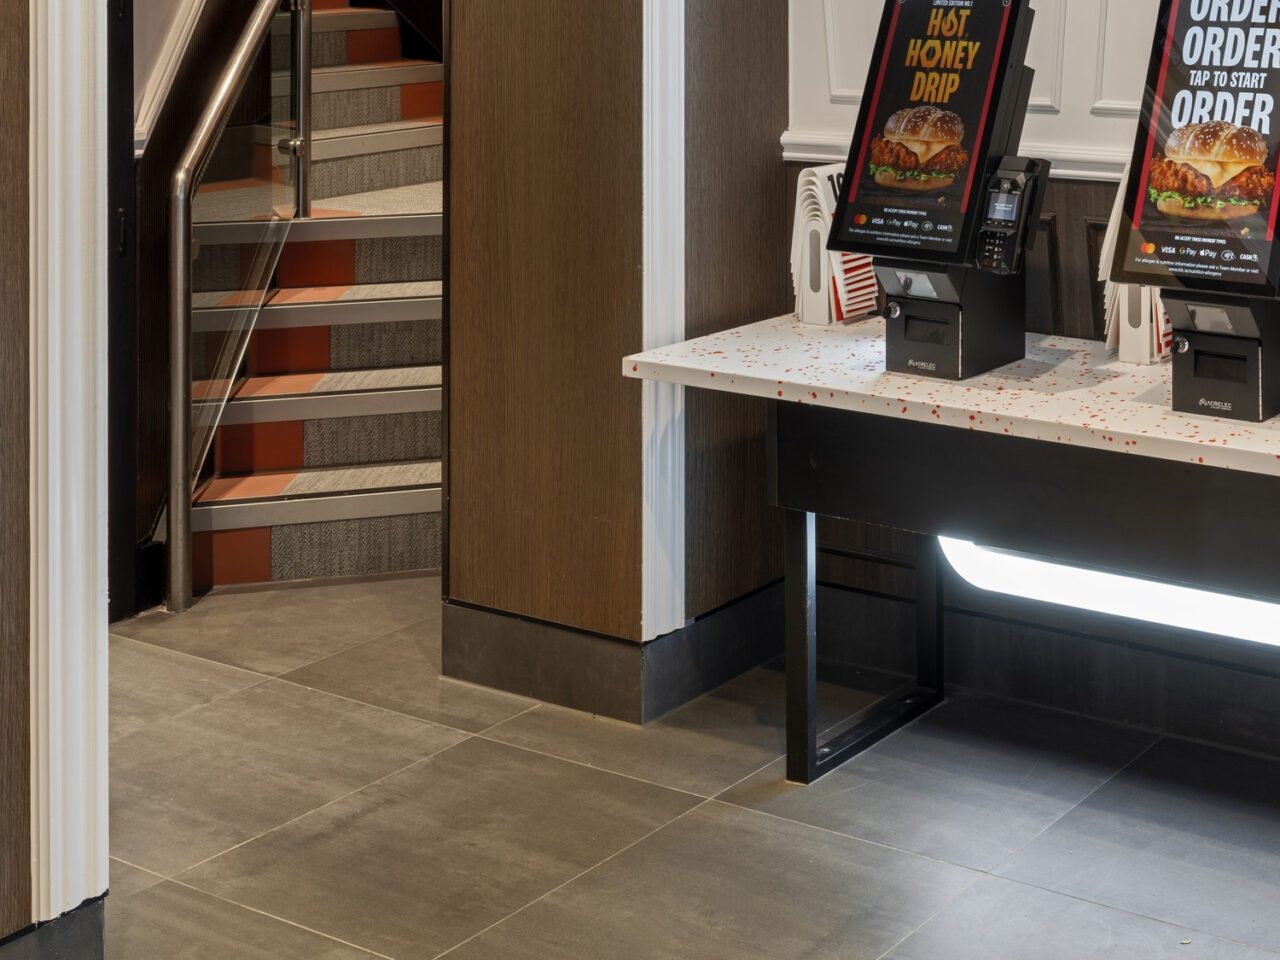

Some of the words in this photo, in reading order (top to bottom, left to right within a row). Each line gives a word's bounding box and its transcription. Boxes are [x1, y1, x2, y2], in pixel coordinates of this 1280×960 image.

[926, 7, 970, 37] HOT
[905, 39, 980, 70] HONEY
[910, 72, 960, 103] DRIP
[1190, 70, 1210, 86] TAP
[1214, 71, 1228, 87] TO
[1230, 72, 1267, 88] START
[1171, 90, 1274, 134] ORDER
[1186, 248, 1197, 256] Pay
[1208, 401, 1232, 409] ACRELEC
